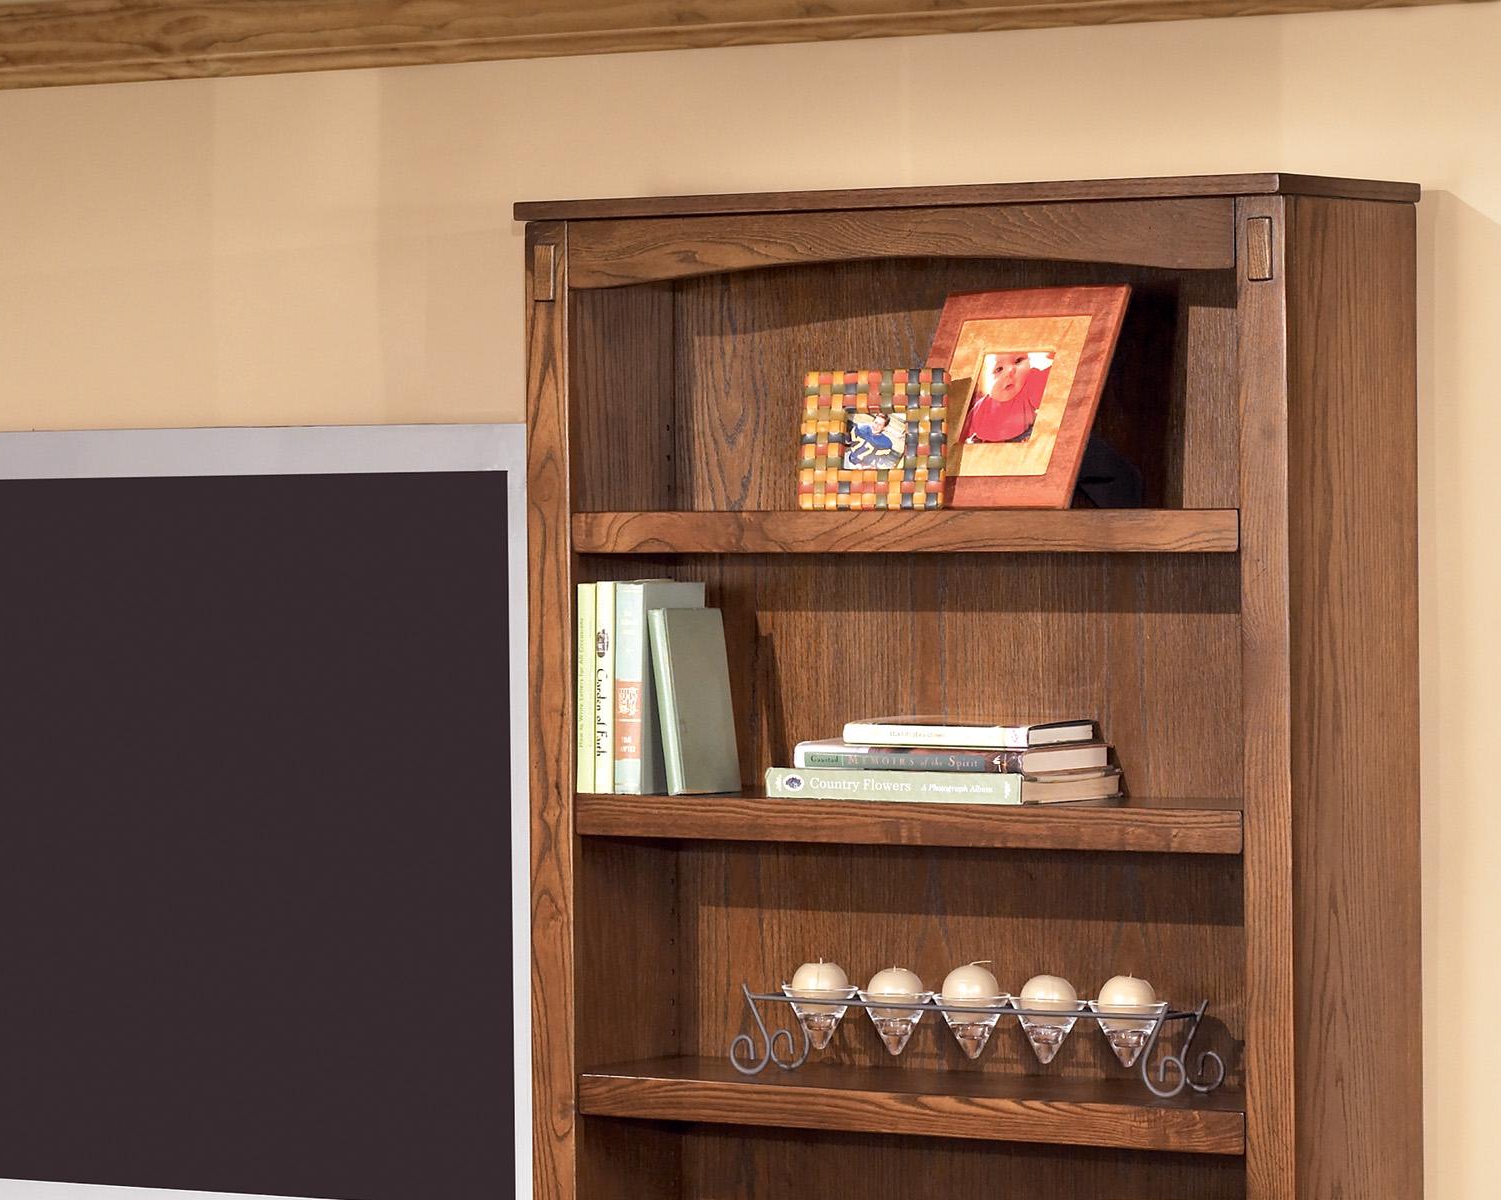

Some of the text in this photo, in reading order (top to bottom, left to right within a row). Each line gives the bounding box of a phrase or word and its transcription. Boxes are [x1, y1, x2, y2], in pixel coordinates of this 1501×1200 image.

[596, 668, 608, 712] Garden
[597, 715, 608, 725] of
[810, 777, 860, 791] Country
[863, 778, 912, 792] Flowers
[929, 784, 968, 794] Photograph
[969, 784, 993, 793] Album
